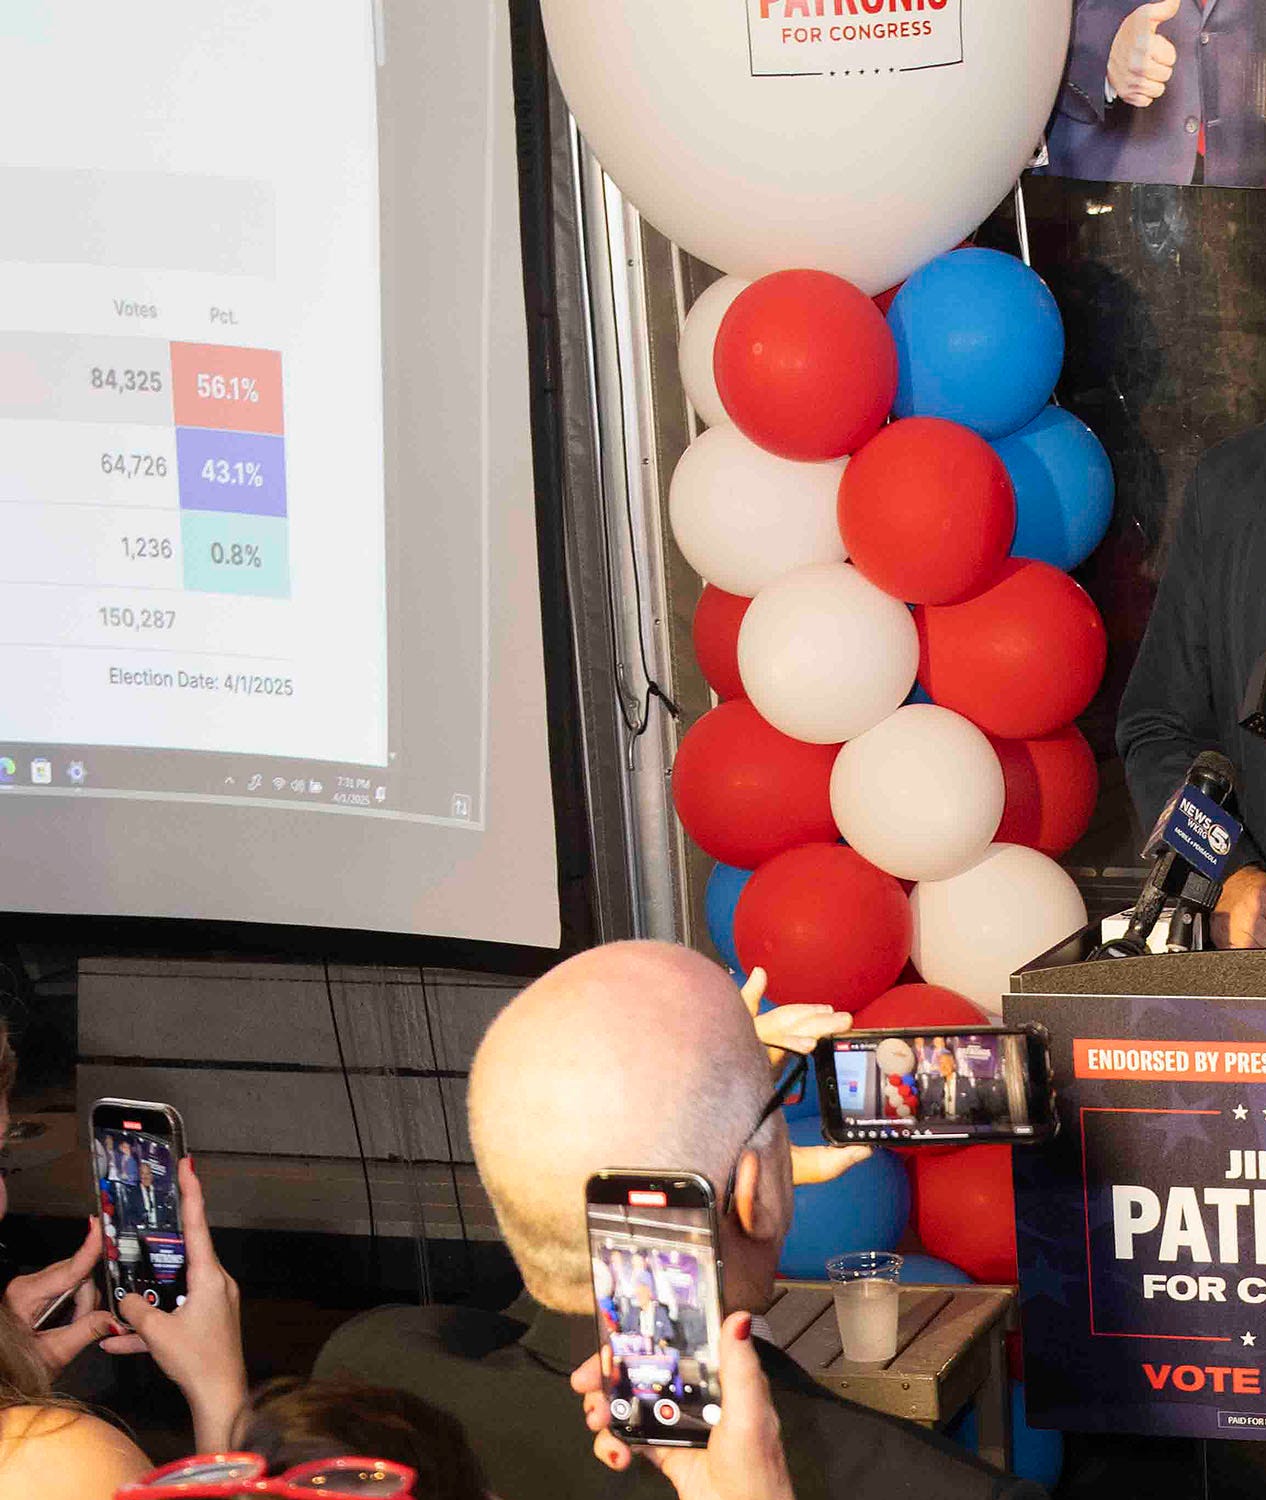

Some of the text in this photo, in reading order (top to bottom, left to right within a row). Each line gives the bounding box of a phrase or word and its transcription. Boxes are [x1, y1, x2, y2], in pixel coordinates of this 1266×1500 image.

[781, 20, 933, 44] FOR CONGRESS
[113, 300, 158, 319] Votes
[90, 367, 259, 403] 84,325 56.1%
[100, 453, 264, 487] 64,726 43.1%
[121, 536, 262, 568] 1,236 0.8%
[99, 607, 176, 632] 150,287
[109, 667, 294, 696] Election Date: 4/1/2025
[1180, 797, 1212, 829] NEWS
[1187, 818, 1208, 840] WKRG
[1087, 1048, 1189, 1073] ENDORSED
[1194, 1051, 1219, 1073] BY
[1142, 1274, 1227, 1302] FOR
[1142, 1364, 1261, 1394] VOTE
[1227, 1416, 1246, 1424] PAID
[1247, 1417, 1264, 1425] FOR
